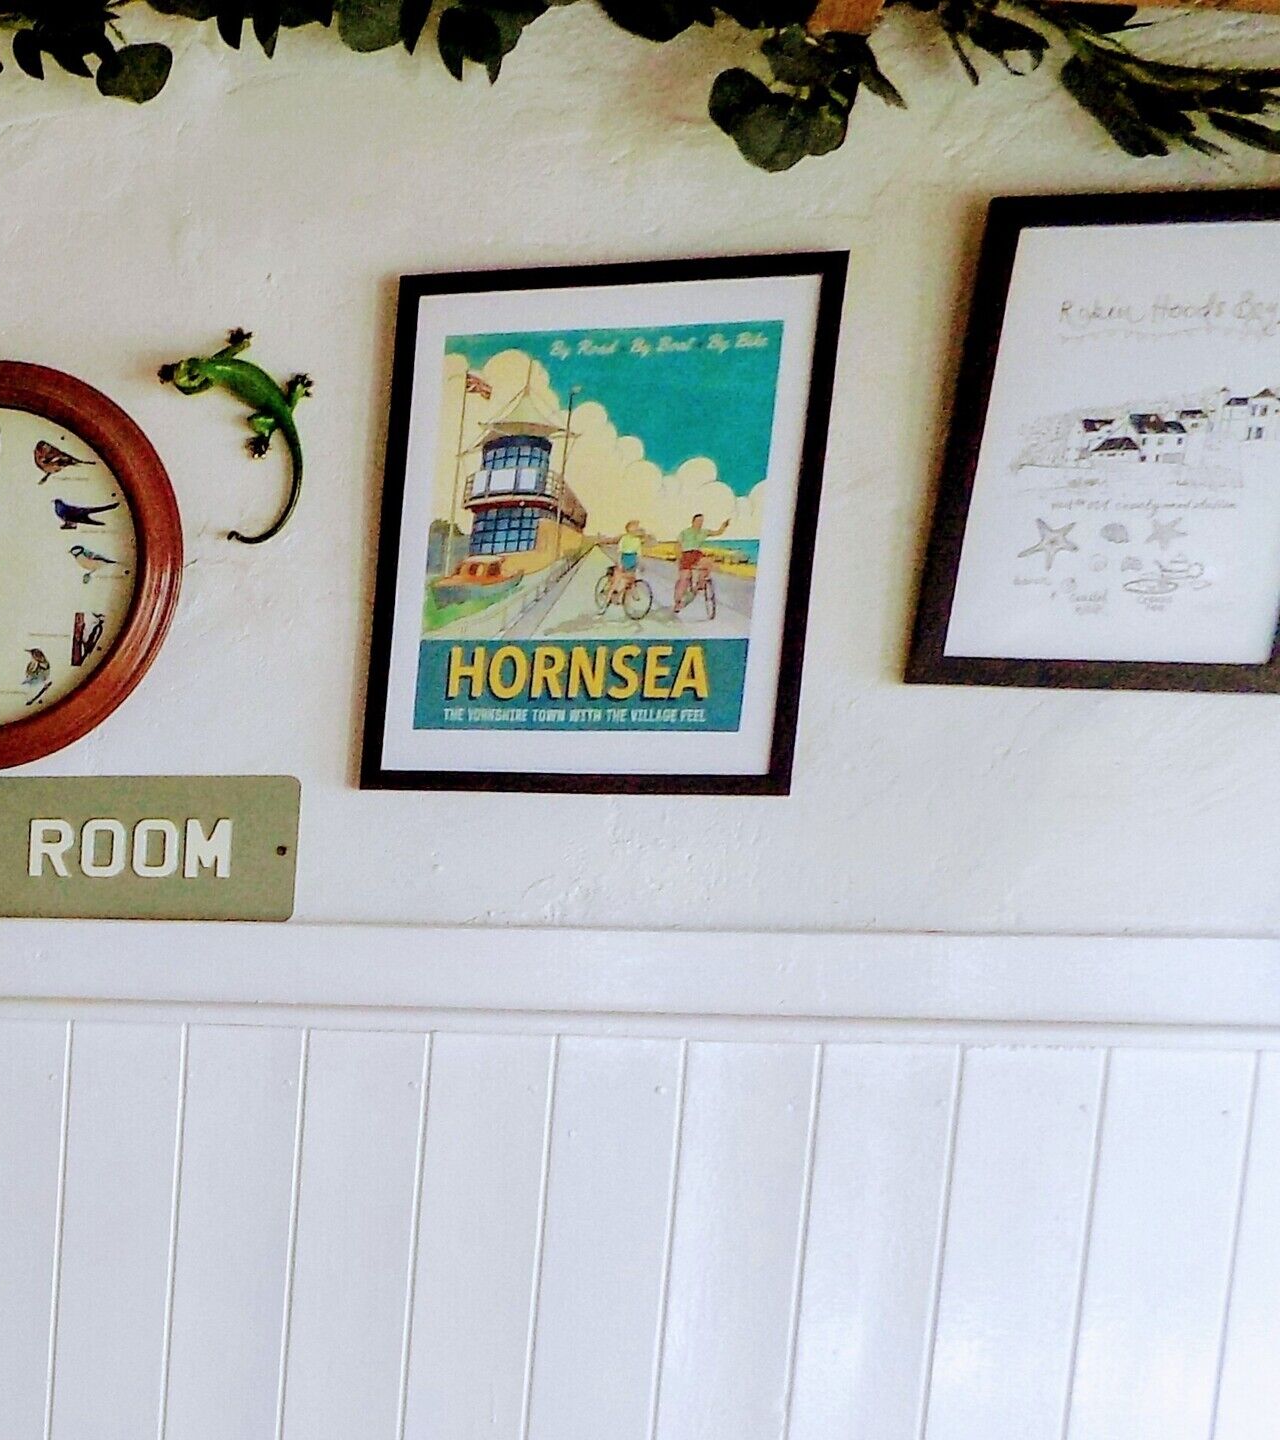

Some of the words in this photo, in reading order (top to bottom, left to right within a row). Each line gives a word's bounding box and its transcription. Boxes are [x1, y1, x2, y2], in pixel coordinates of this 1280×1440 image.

[445, 644, 710, 701] HORNSEA
[443, 707, 465, 722] THE
[468, 707, 528, 722] YORKSHIRE
[532, 707, 566, 722] TOWN
[568, 707, 602, 722] WITH
[606, 707, 628, 722] THE
[630, 707, 677, 722] VILLAGE
[679, 707, 707, 722] FEEL
[28, 817, 233, 878] ROOM
